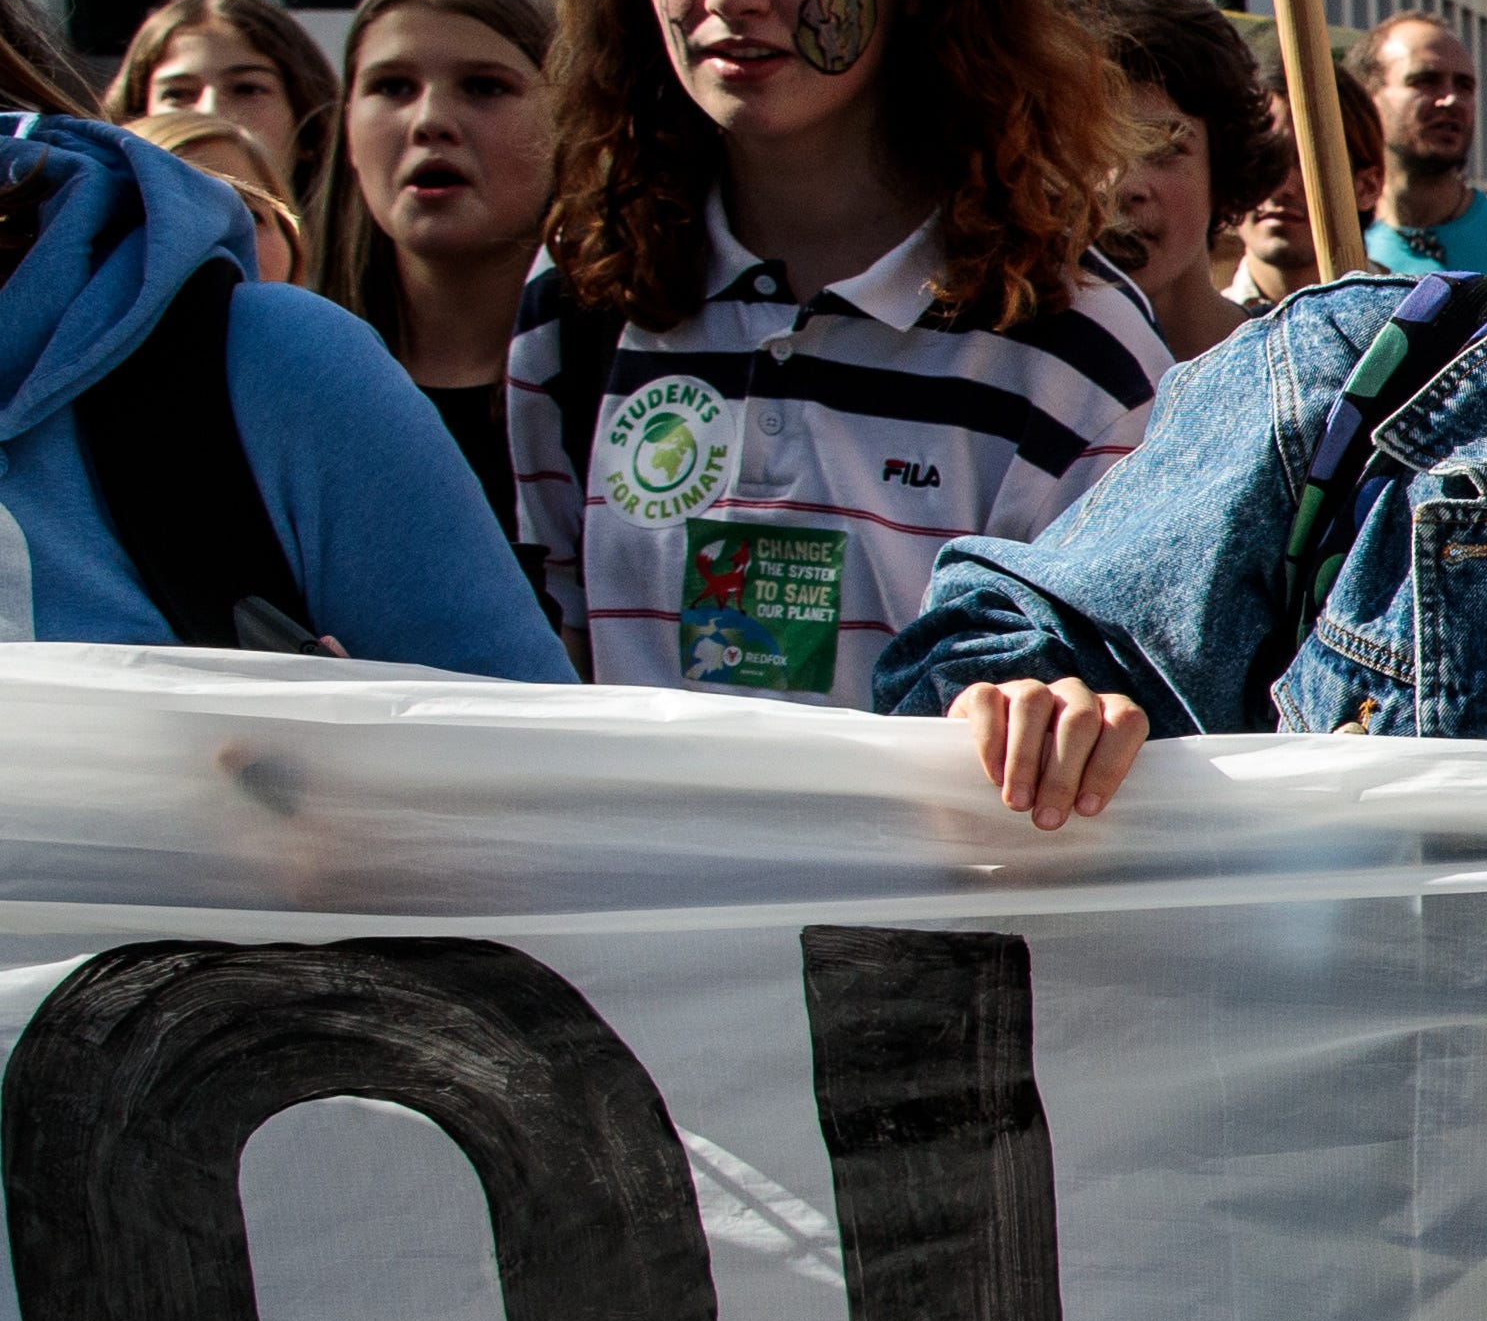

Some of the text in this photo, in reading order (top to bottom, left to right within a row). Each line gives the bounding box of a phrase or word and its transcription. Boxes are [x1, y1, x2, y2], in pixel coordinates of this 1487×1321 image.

[608, 383, 721, 448] STUDENTS
[606, 444, 728, 520] FOR CLIMATE
[882, 458, 941, 489] FILA
[756, 538, 833, 562] CHANGE
[758, 560, 785, 577] THE
[754, 579, 832, 607] TO SAVE
[756, 604, 836, 622] OUR PLANET
